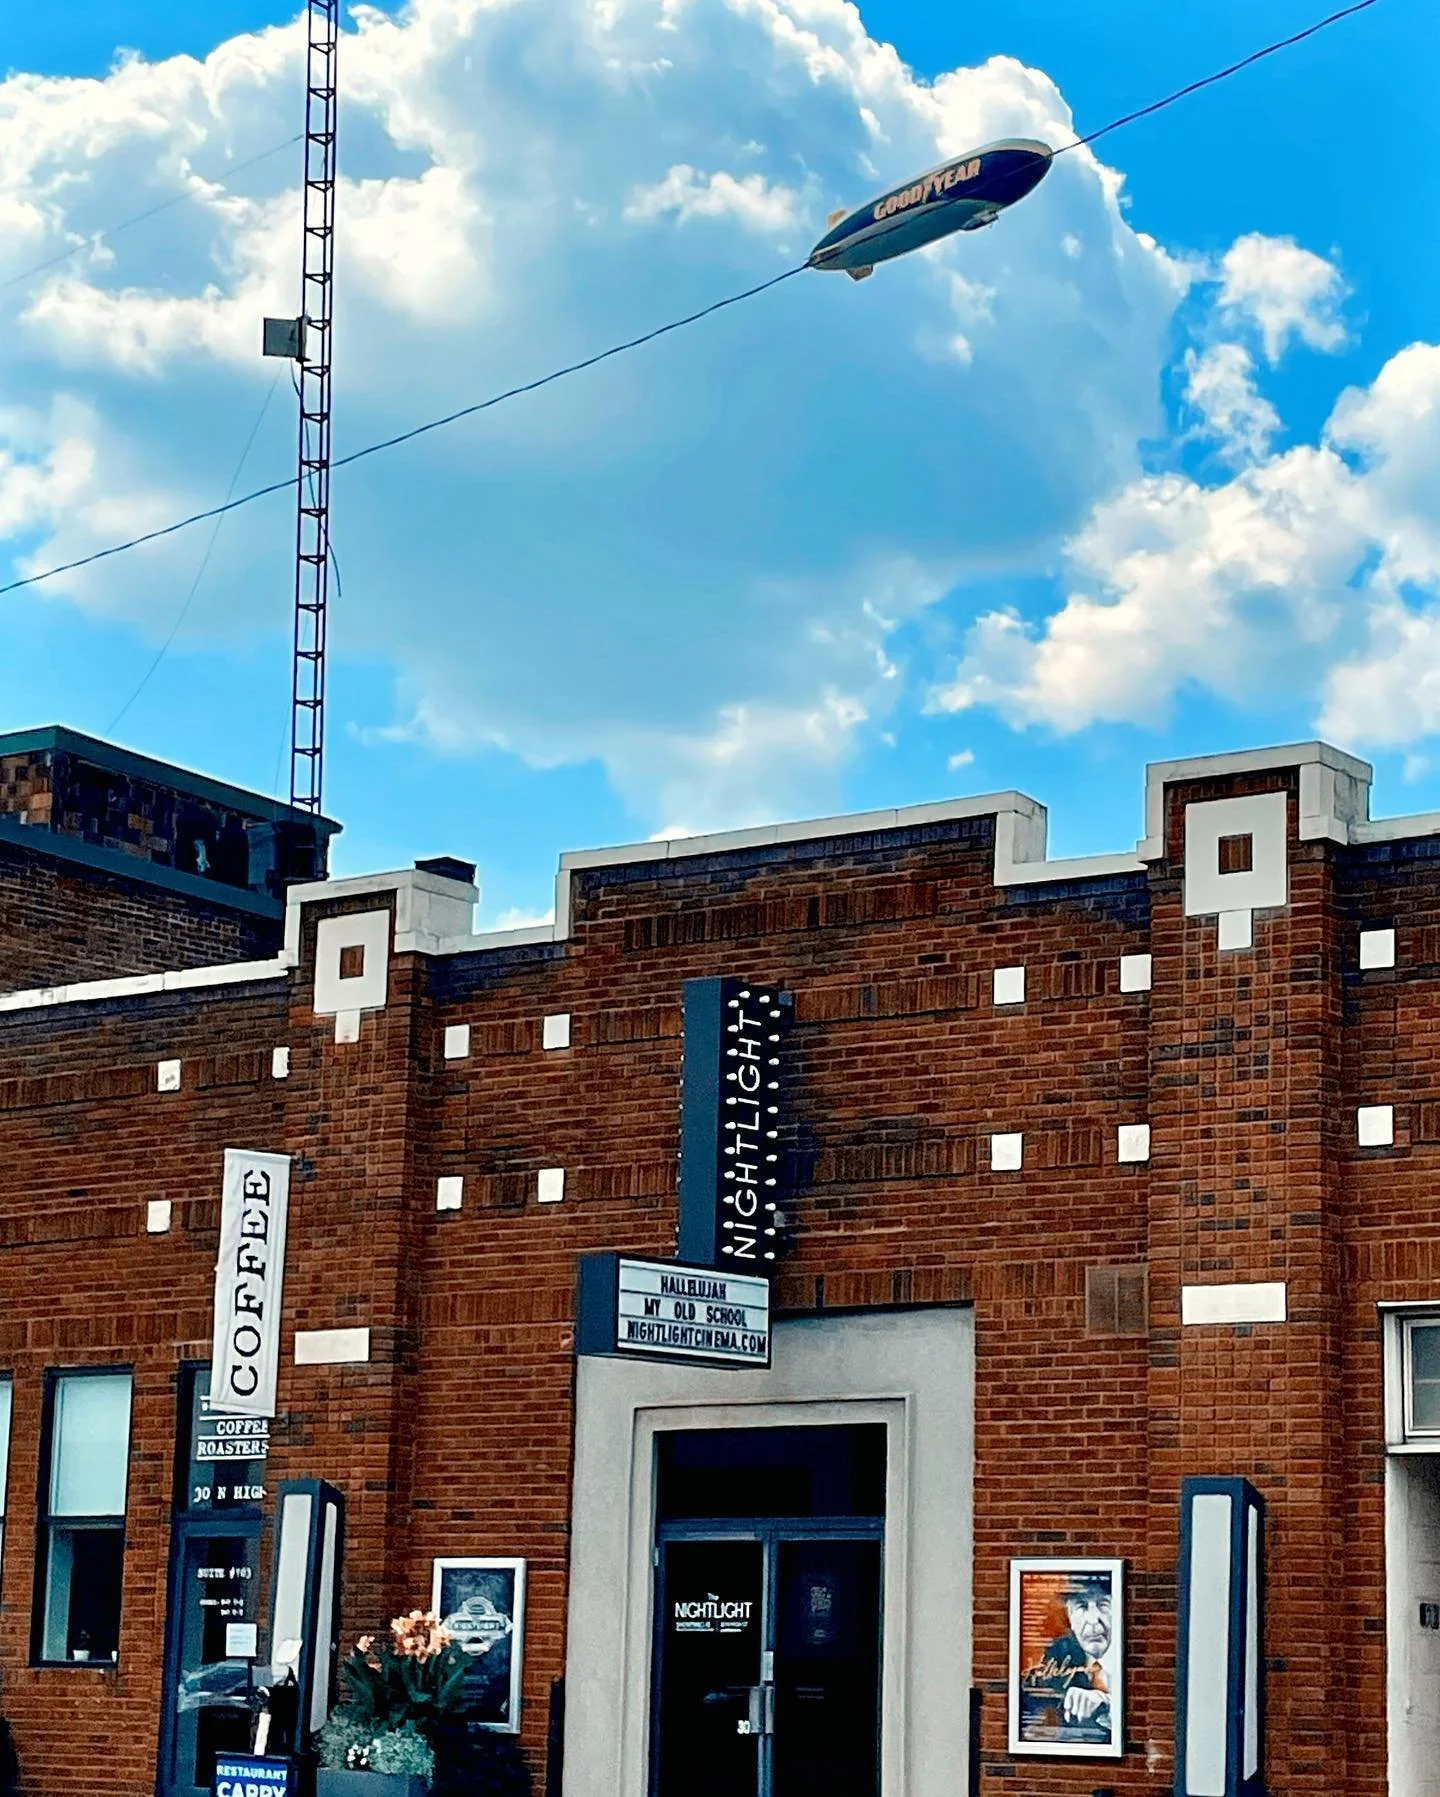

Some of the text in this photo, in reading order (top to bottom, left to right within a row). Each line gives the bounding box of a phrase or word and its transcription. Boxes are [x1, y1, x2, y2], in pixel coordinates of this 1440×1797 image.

[873, 158, 981, 220] GOODYEAR
[733, 1009, 762, 1259] NIGHTLIGHT
[230, 1169, 271, 1397] COFFEE
[660, 1275, 727, 1300] HALLELUJAH
[644, 1297, 748, 1328] MY OLD SCHOOL
[627, 1320, 767, 1353] NIGHTLIGHTCINEMA.COM
[216, 1420, 269, 1435] COFFEE
[197, 1440, 270, 1455] ROASTERS
[217, 1486, 227, 1500] N
[674, 1601, 753, 1619] NIGHTLIGHT
[216, 1765, 288, 1781] RESTAURANT
